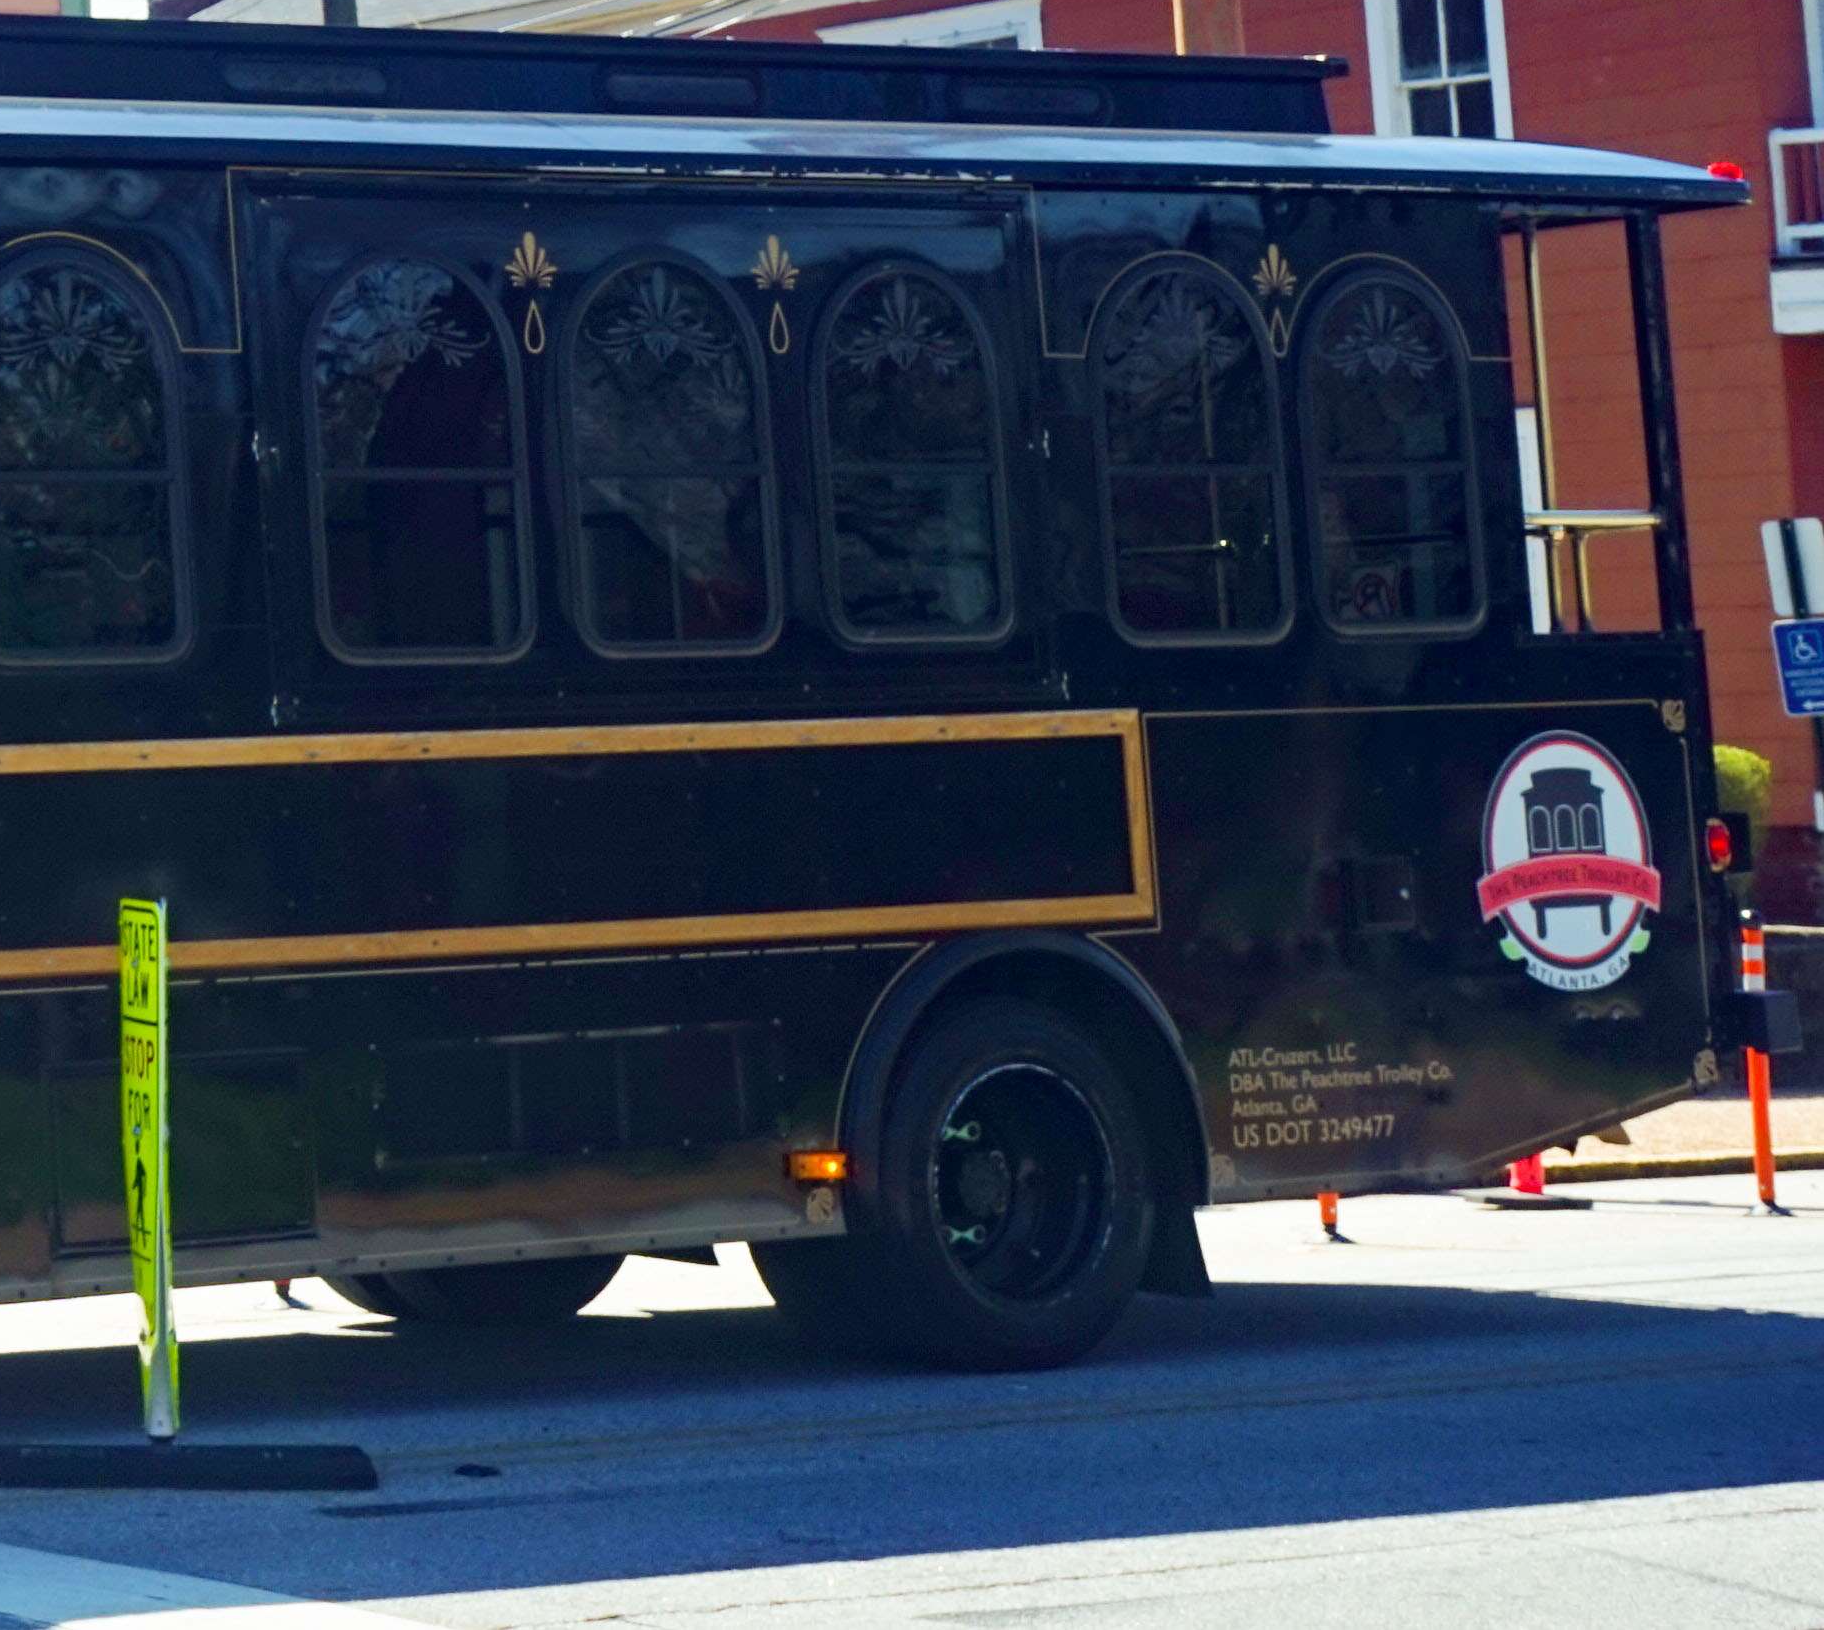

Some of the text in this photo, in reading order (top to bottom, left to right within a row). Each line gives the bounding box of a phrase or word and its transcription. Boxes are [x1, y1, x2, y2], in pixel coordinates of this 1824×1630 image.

[122, 921, 156, 962] STATE
[1608, 956, 1630, 976] GA
[127, 971, 150, 1009] LAW
[124, 1035, 154, 1079] STOP
[1327, 1042, 1357, 1064] LLC
[1270, 1071, 1298, 1091] The
[1303, 1069, 1372, 1088] Peachtree
[1376, 1064, 1424, 1086] Trolley
[128, 1089, 151, 1130] FOR
[1292, 1094, 1318, 1114] GA
[1233, 1114, 1395, 1148] US DOT 3249477
